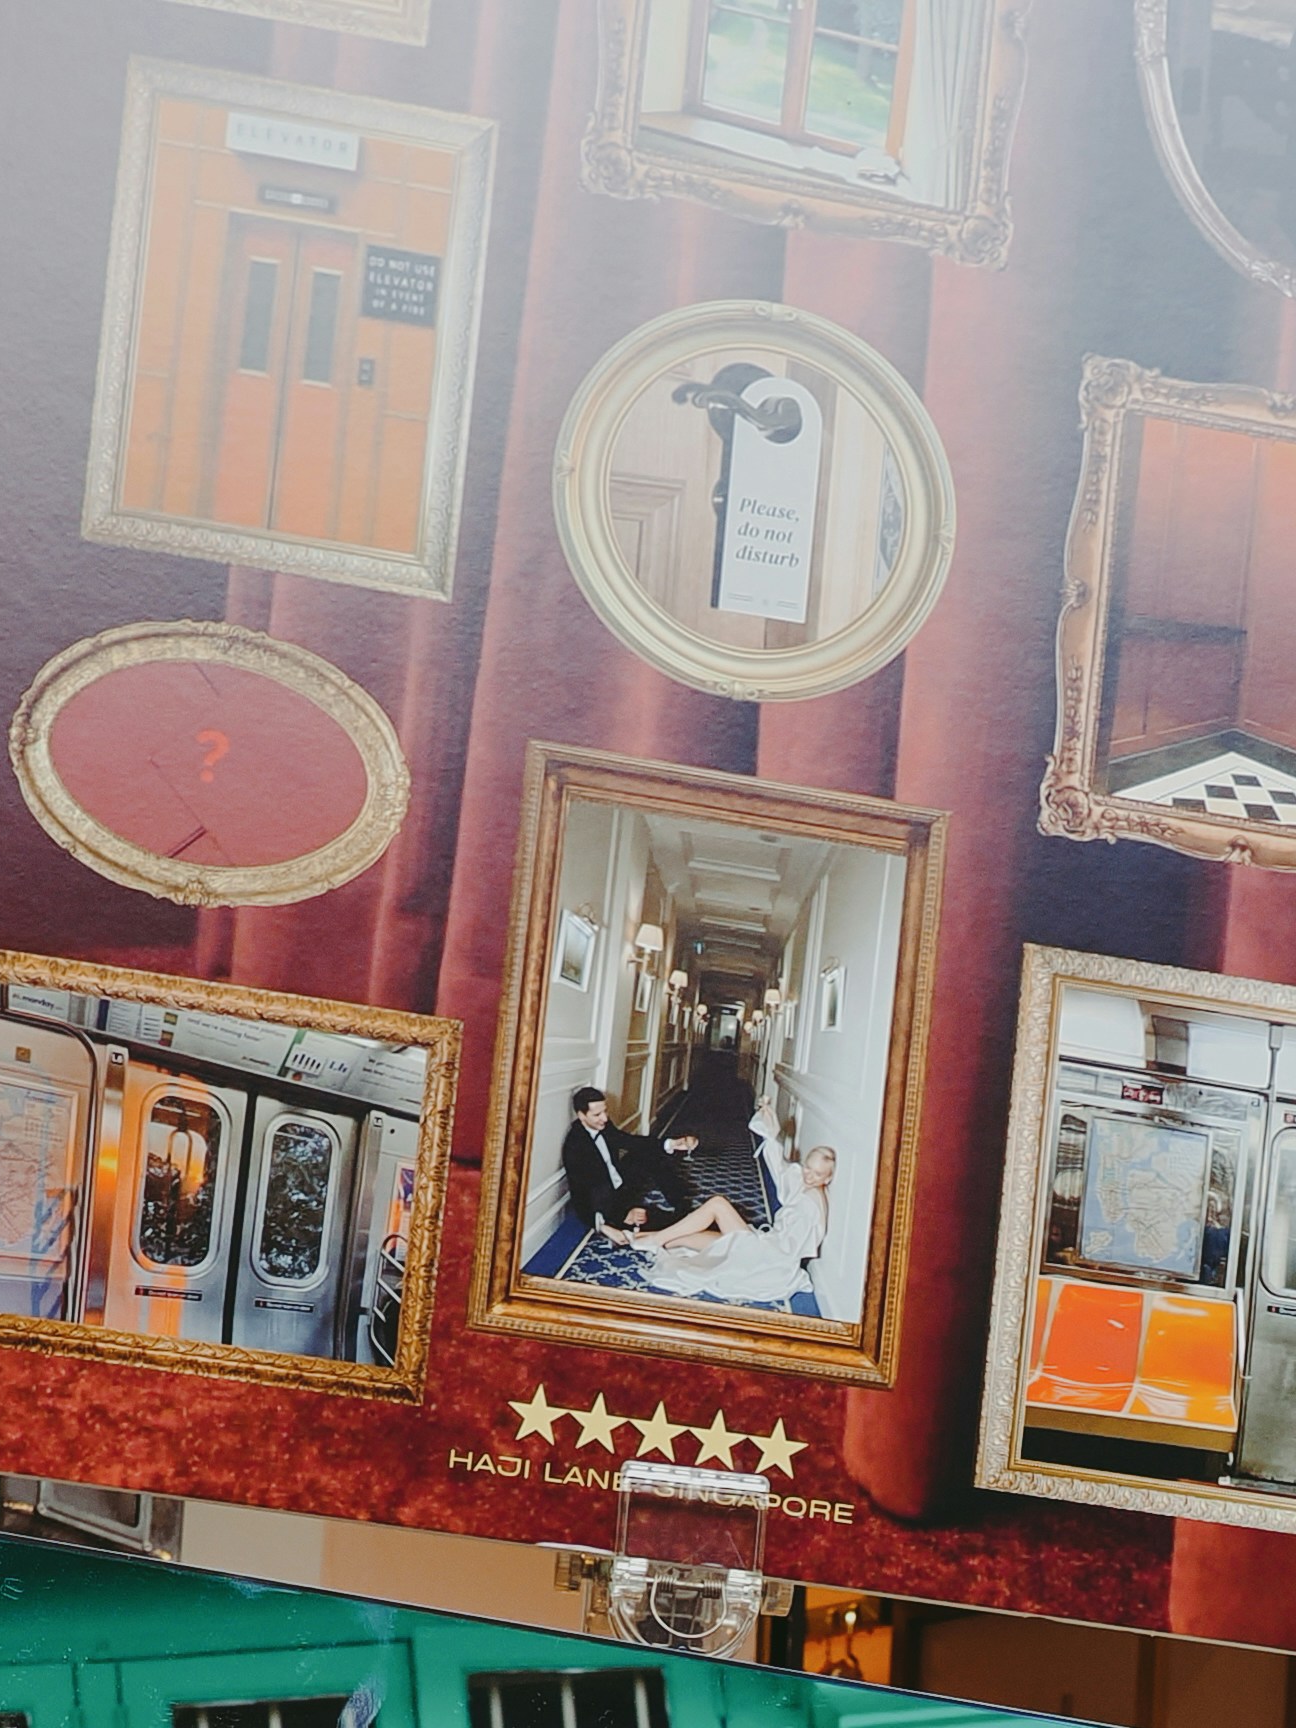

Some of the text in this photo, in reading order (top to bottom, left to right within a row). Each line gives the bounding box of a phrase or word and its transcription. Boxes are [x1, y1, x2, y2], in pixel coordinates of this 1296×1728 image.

[236, 122, 349, 153] ELEVATOR
[368, 255, 436, 278] DO NOT USE
[369, 271, 434, 291] ELEVATOR
[739, 497, 800, 522] Please,
[737, 521, 793, 544] do not
[735, 544, 800, 568] disturb
[448, 1448, 531, 1480] HAJI
[654, 1482, 856, 1525] SINGAPORE
